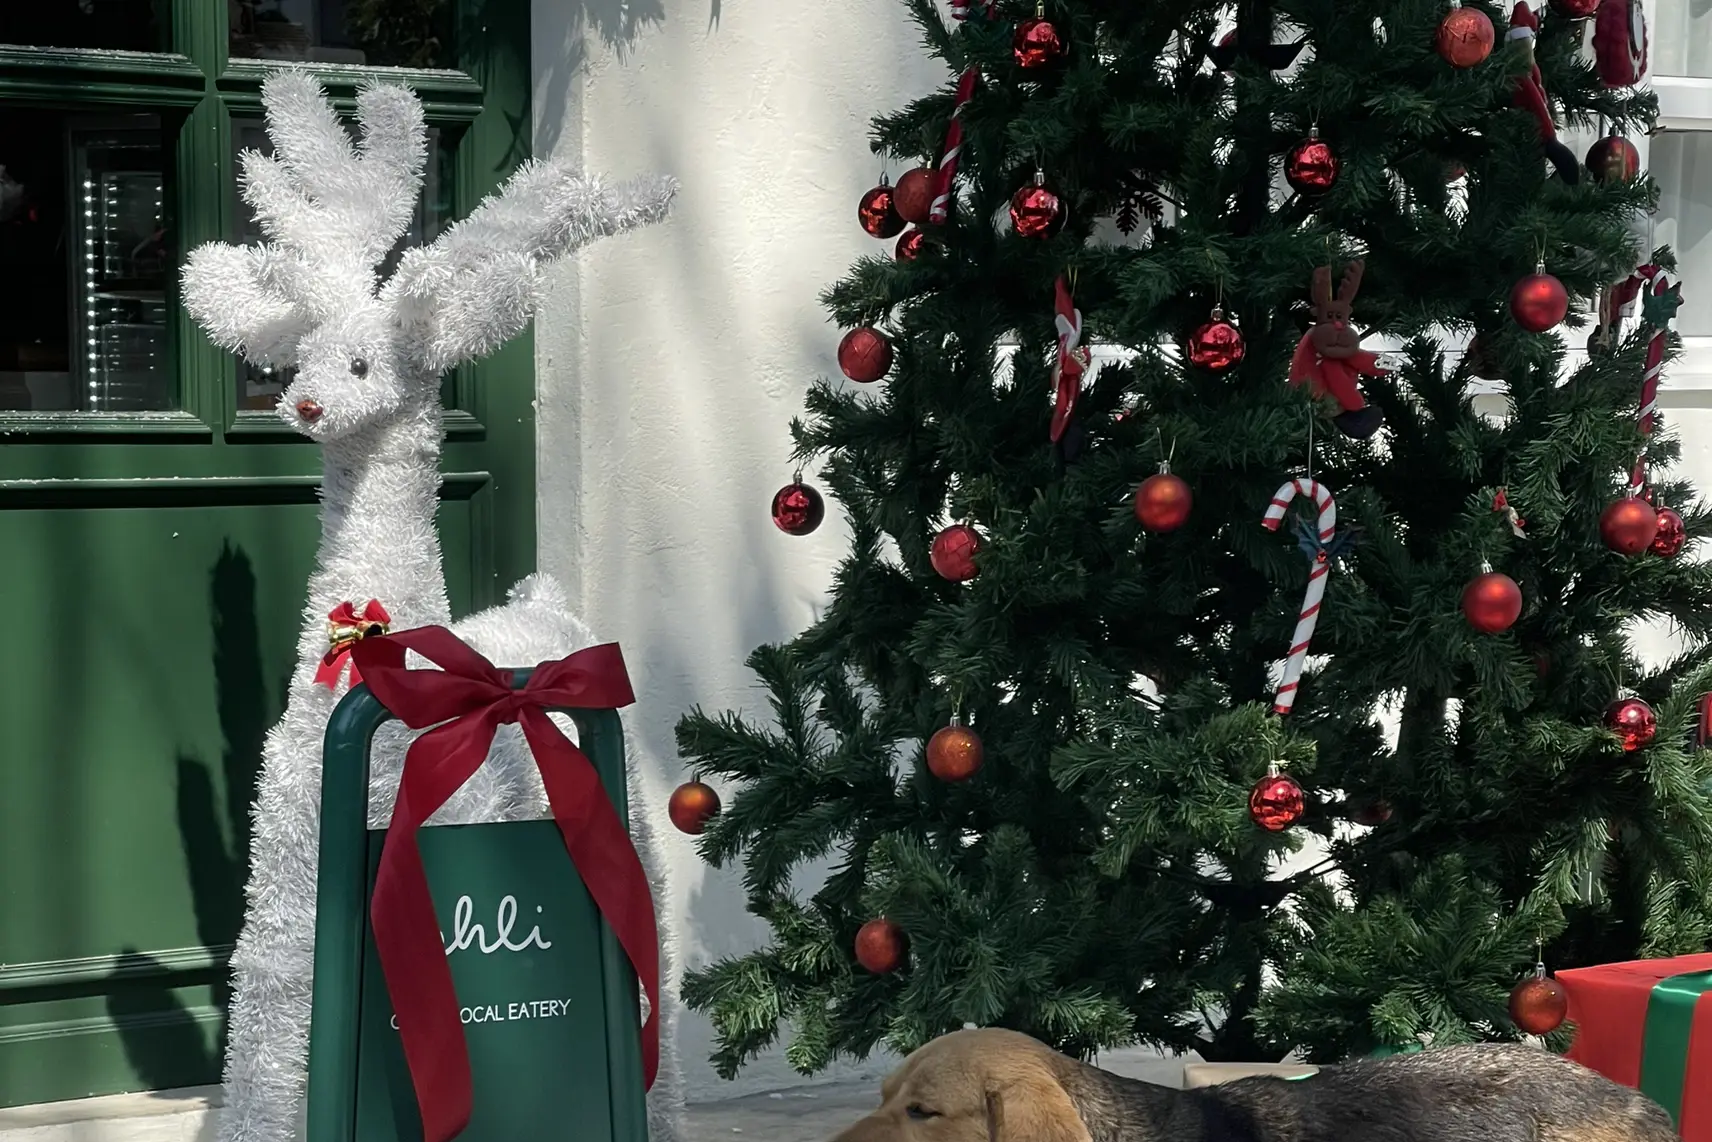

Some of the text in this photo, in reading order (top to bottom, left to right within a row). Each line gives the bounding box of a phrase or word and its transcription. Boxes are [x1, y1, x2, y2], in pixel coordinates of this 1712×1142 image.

[440, 895, 552, 956] hli
[460, 999, 571, 1024] OCAL EATERY
